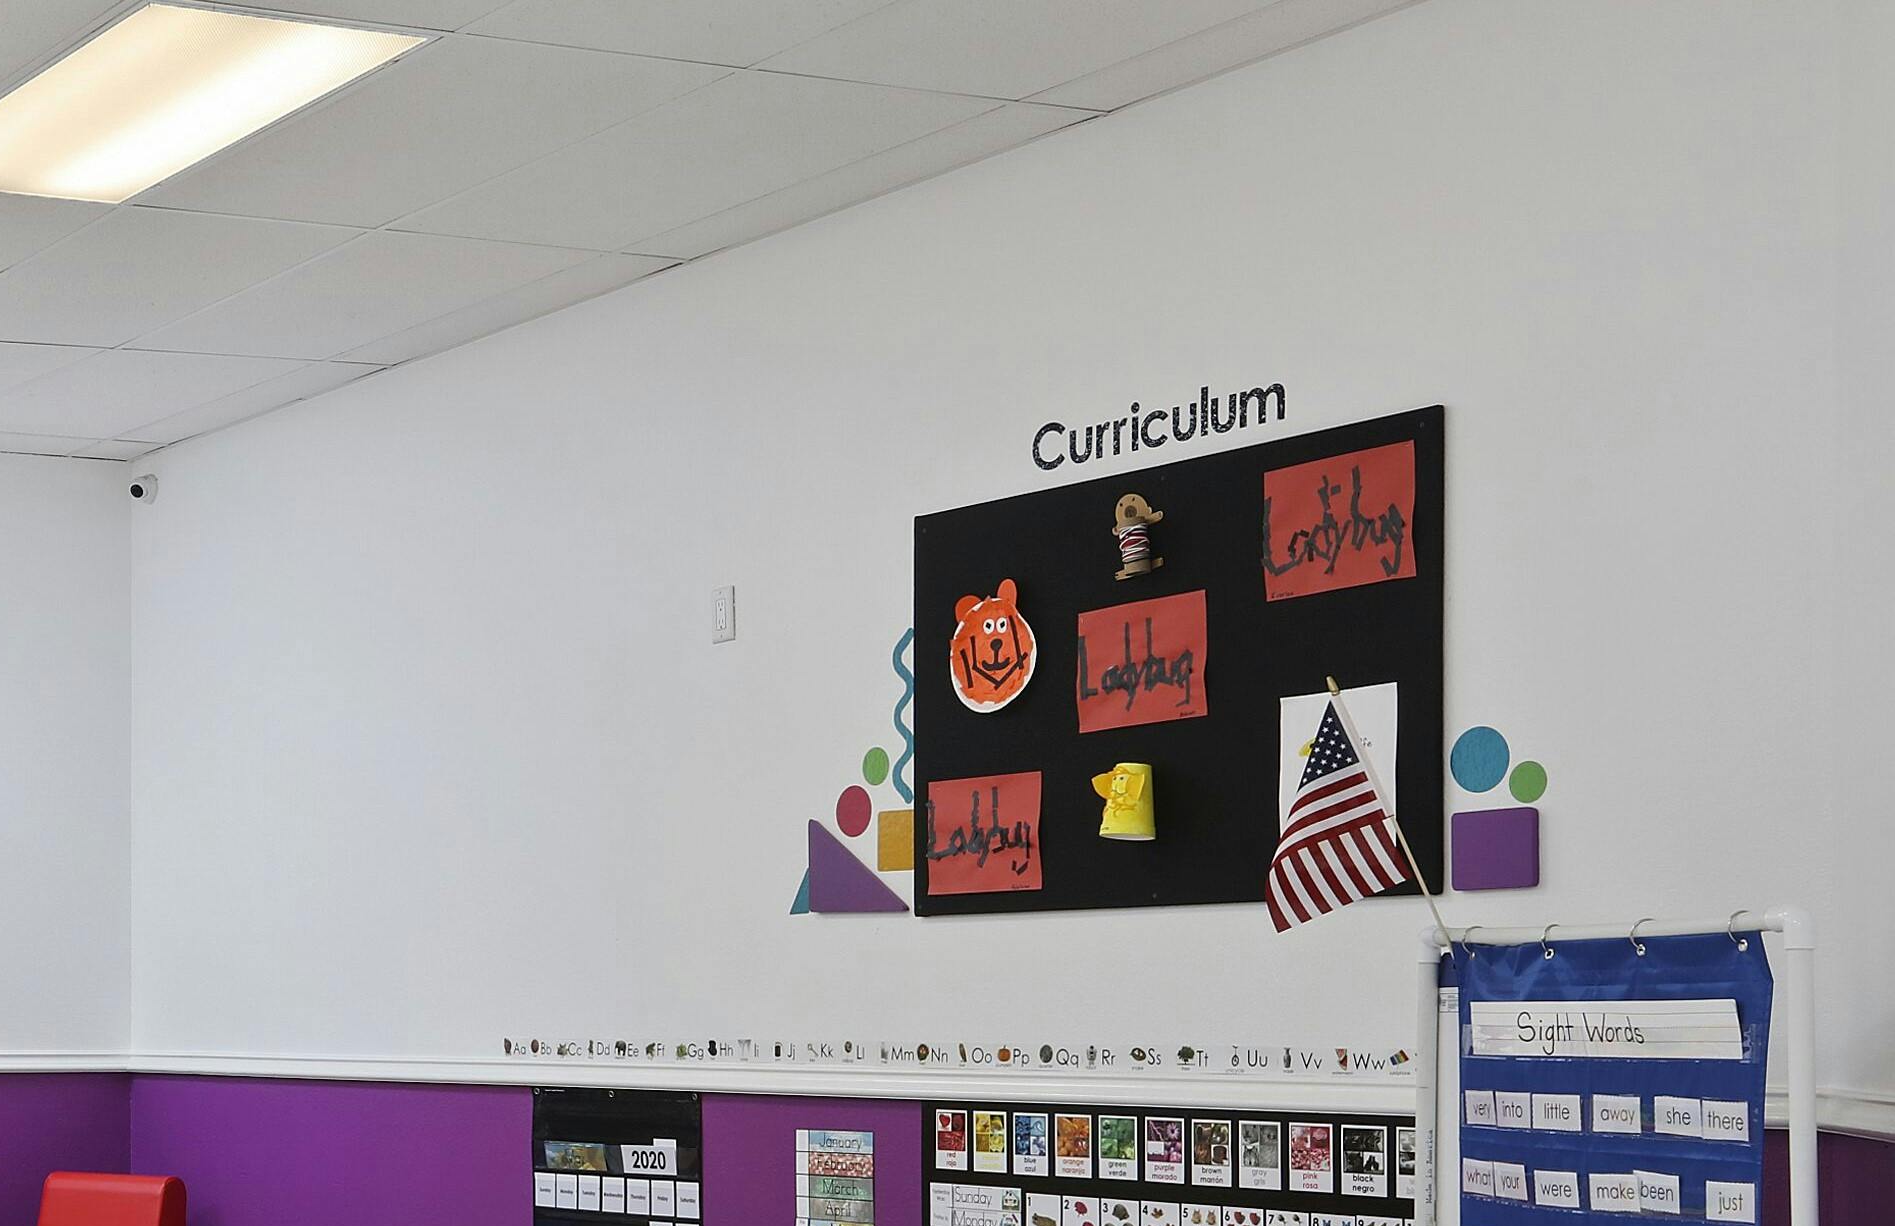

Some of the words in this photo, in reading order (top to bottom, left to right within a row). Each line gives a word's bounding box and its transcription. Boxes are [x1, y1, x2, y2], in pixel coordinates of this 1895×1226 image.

[1031, 382, 1287, 471] Curriculum
[1262, 465, 1406, 577] Ladybug
[1077, 617, 1194, 710] Ladybug
[1516, 1011, 1574, 1056] Sight
[1582, 1012, 1645, 1045] Words
[1012, 1049, 1030, 1066] Pp
[1055, 1049, 1079, 1069] Qq
[1101, 1049, 1116, 1066] Rr
[1246, 1050, 1268, 1069] Uu
[1301, 1052, 1322, 1070] Vv
[1352, 1053, 1387, 1071] Ww
[1502, 1101, 1523, 1119] into
[1543, 1102, 1570, 1120] little
[1601, 1107, 1635, 1125] away
[1666, 1107, 1691, 1126] she
[1708, 1111, 1744, 1131] there
[631, 1150, 666, 1170] 2020
[1352, 1174, 1374, 1183] black
[1352, 1184, 1375, 1194] negro
[1466, 1168, 1491, 1185] what
[1501, 1174, 1519, 1191] your
[1541, 1182, 1572, 1198] were
[1597, 1183, 1634, 1200] make
[1640, 1181, 1674, 1202] been
[1718, 1191, 1743, 1215] just
[954, 1186, 992, 1206] Sunday
